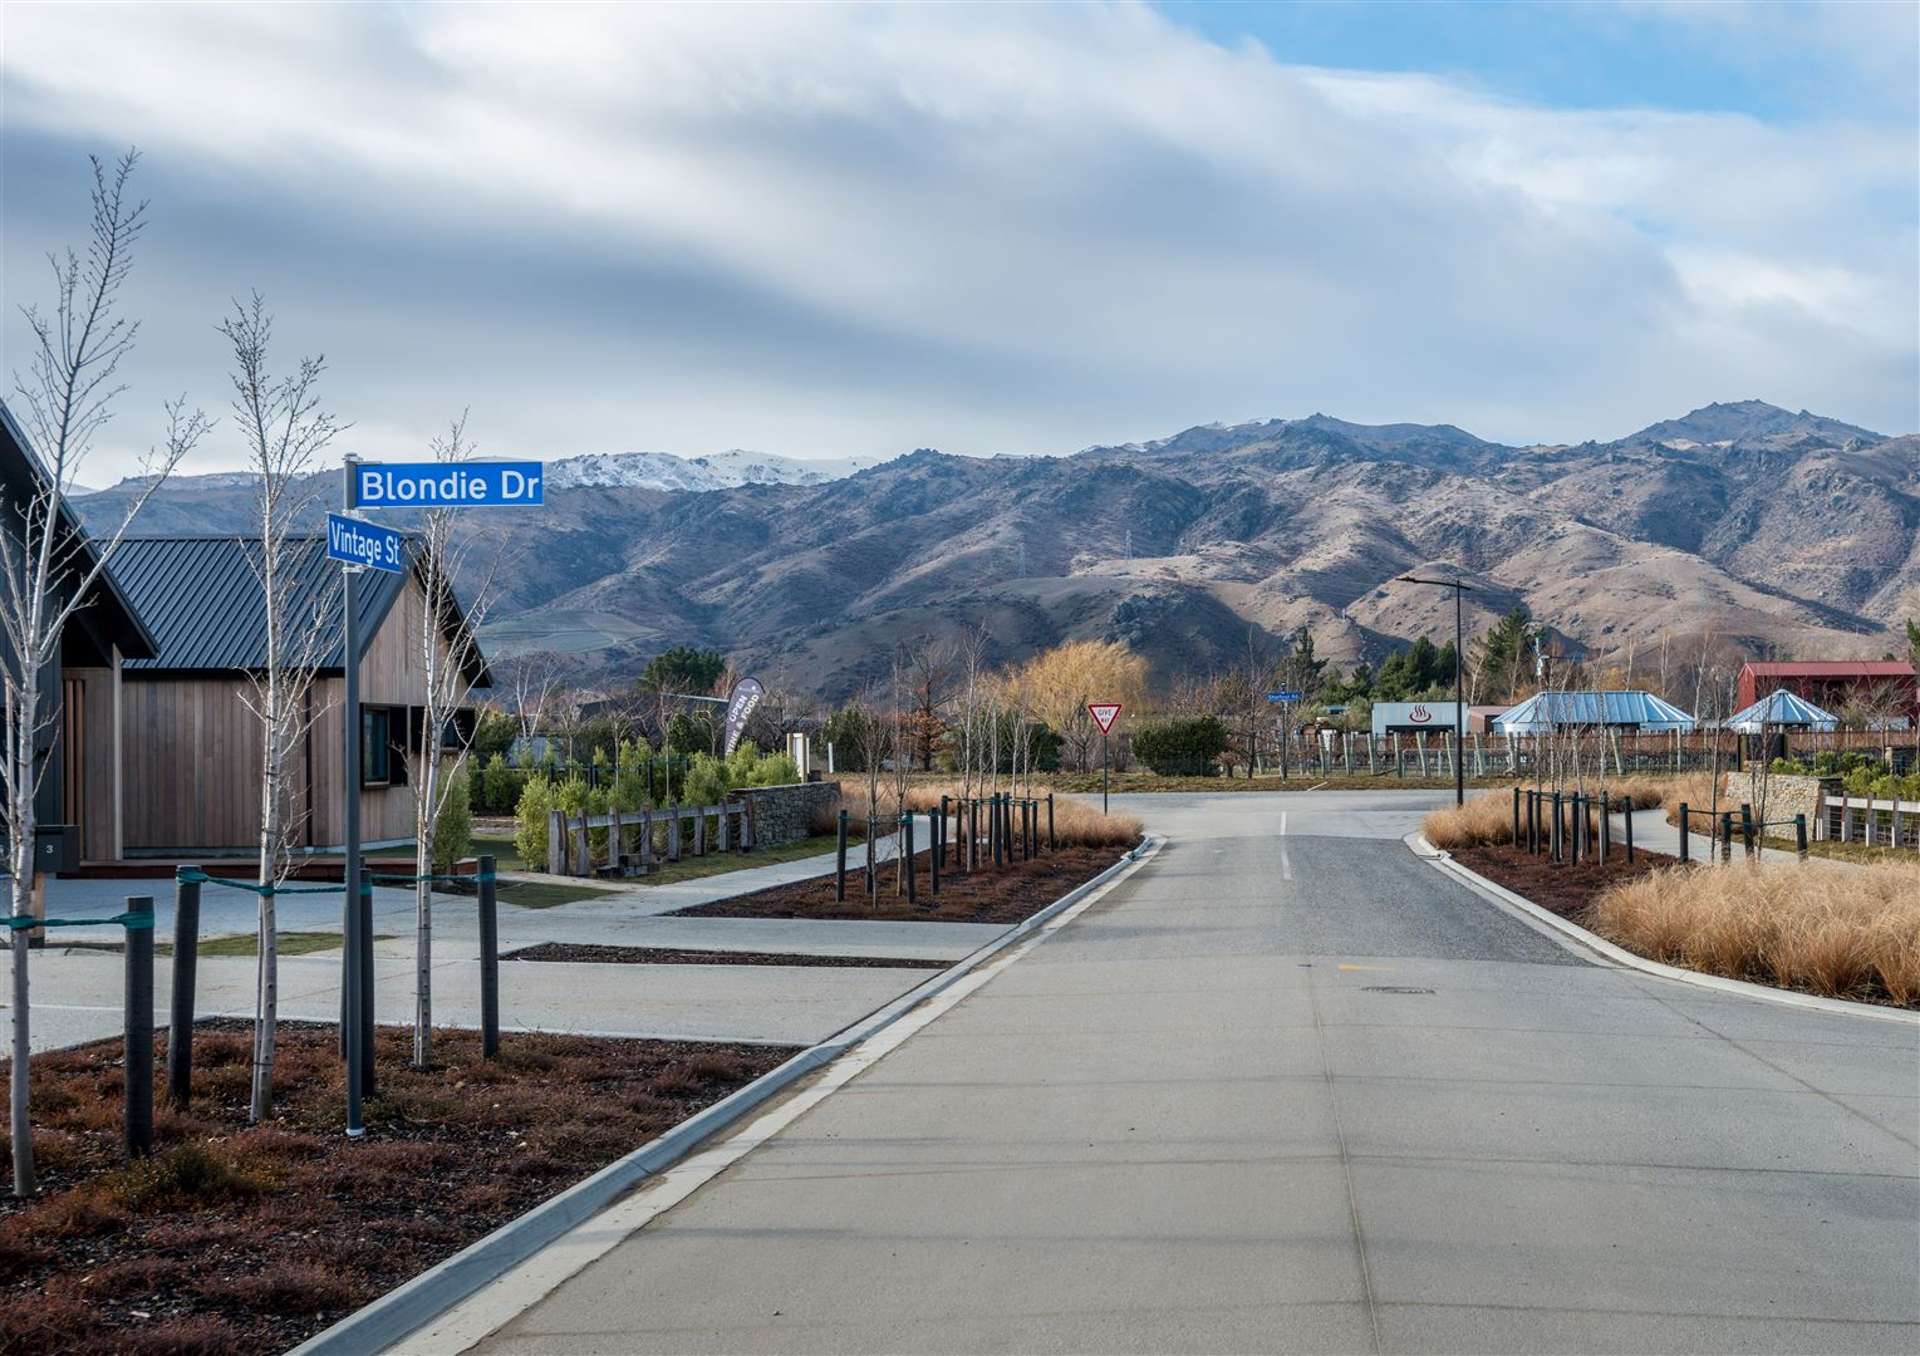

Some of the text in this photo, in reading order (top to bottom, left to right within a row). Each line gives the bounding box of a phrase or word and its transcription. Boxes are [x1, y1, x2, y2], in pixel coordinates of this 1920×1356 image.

[362, 470, 540, 500] Blondie Dr
[330, 520, 400, 565] Vintage St
[729, 694, 748, 721] OPEN
[741, 694, 759, 720] FOOD
[1098, 709, 1112, 717] GIVE
[46, 844, 54, 854] 3
